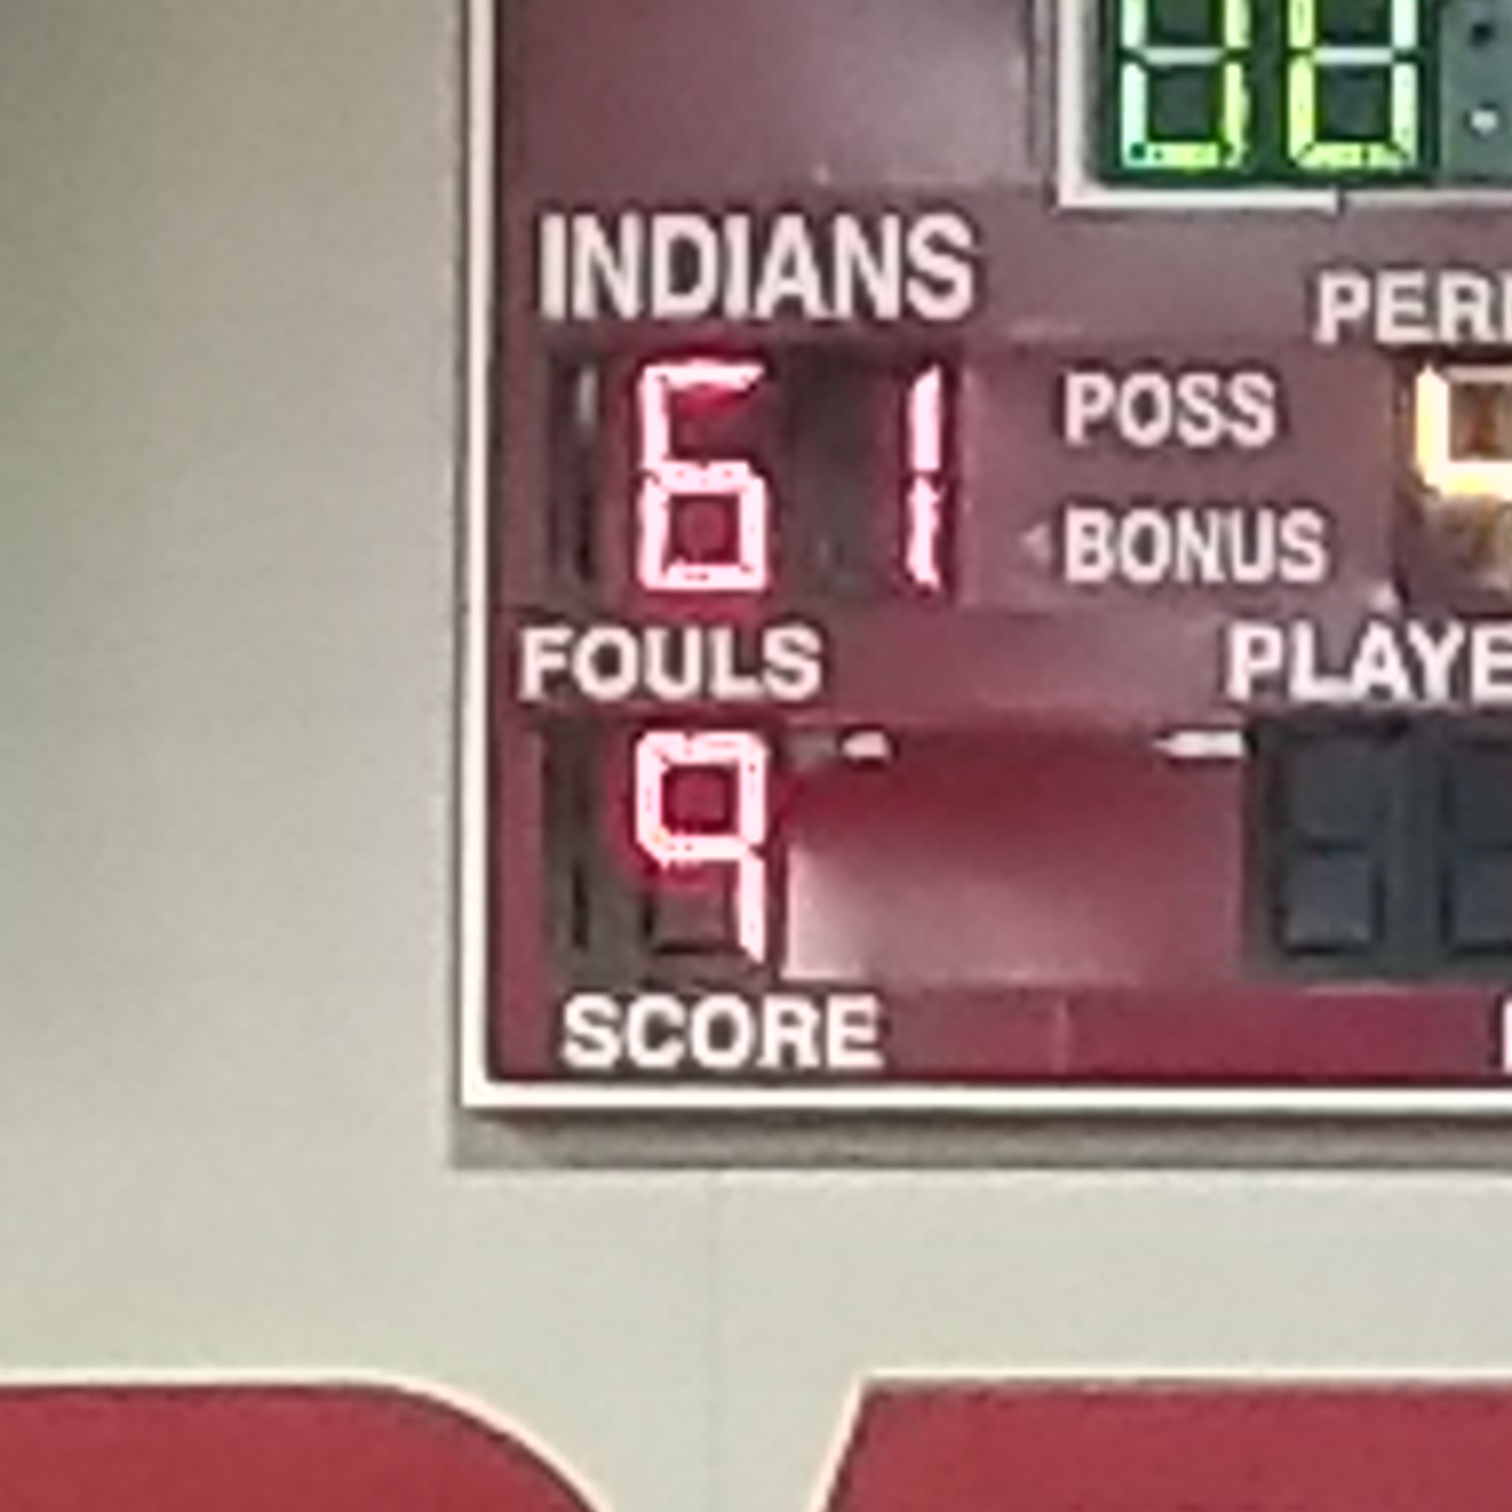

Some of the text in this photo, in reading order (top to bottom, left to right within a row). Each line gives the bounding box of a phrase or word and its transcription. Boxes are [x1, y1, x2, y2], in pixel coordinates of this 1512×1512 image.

[539, 212, 980, 322] INDIANS
[1063, 372, 1277, 448] POSS
[637, 360, 942, 593] 61
[1063, 506, 1327, 584] BONUS
[518, 626, 823, 702] FOULS
[635, 729, 768, 965] 9
[560, 993, 885, 1070] SCORE
